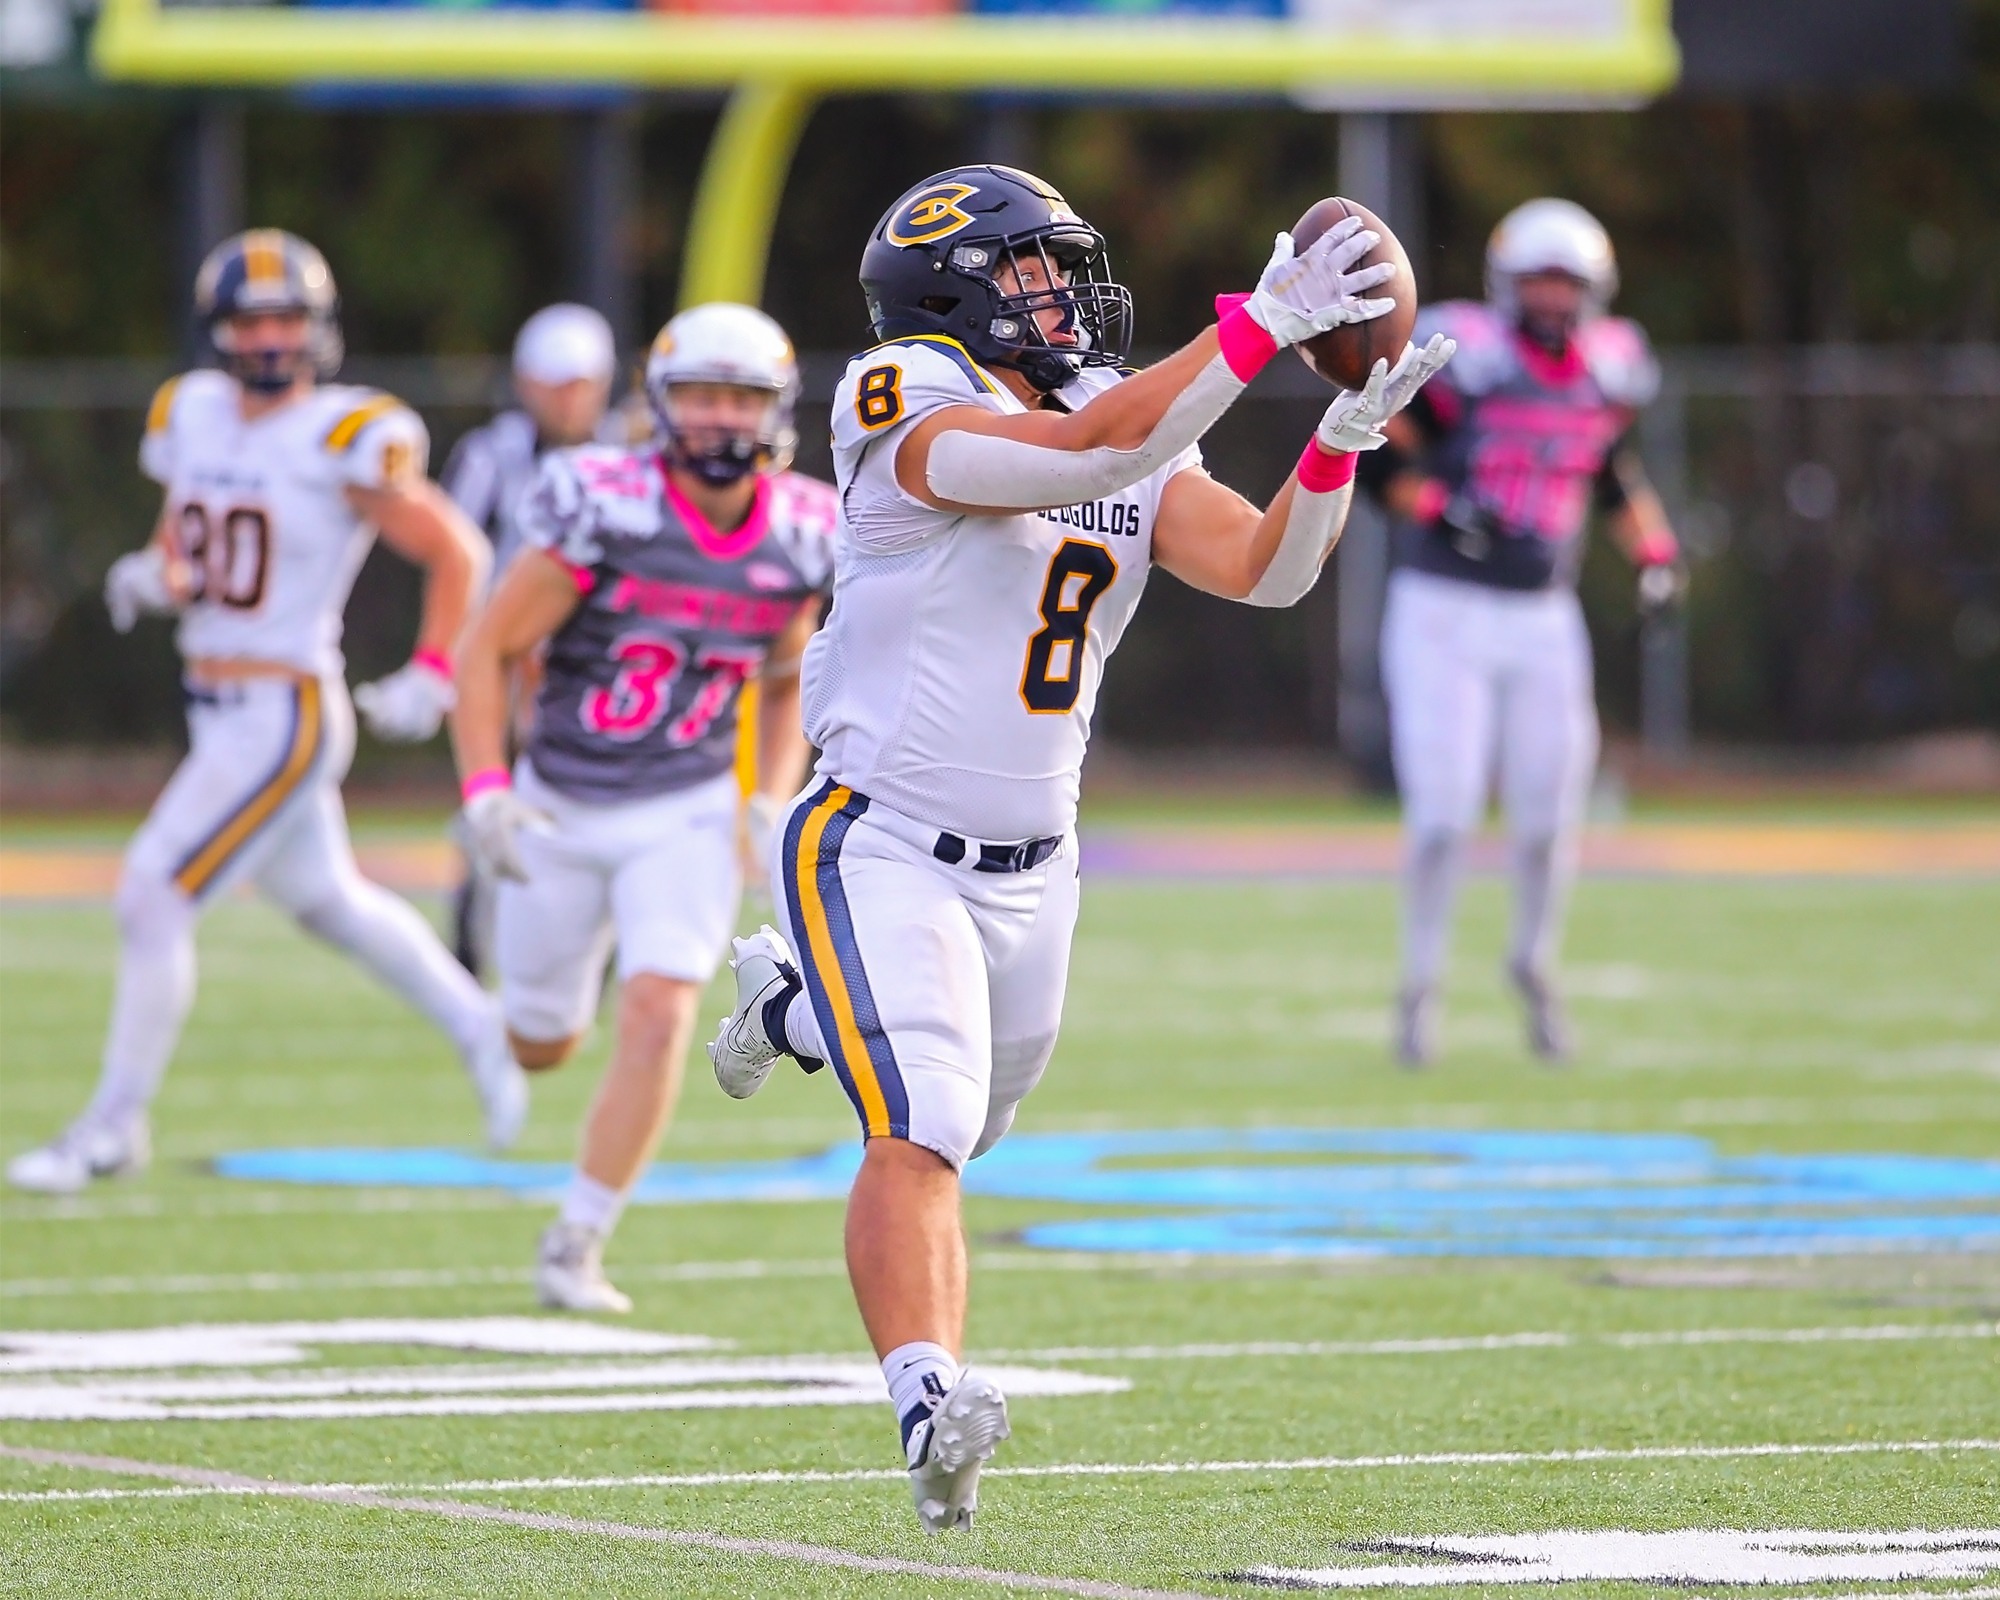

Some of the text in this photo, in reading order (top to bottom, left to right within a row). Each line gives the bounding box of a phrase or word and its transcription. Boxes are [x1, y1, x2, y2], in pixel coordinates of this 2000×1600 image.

[854, 363, 905, 431] 8
[1037, 500, 1140, 536] UGOLDS
[1019, 537, 1118, 715] 8
[578, 633, 768, 748] 37
